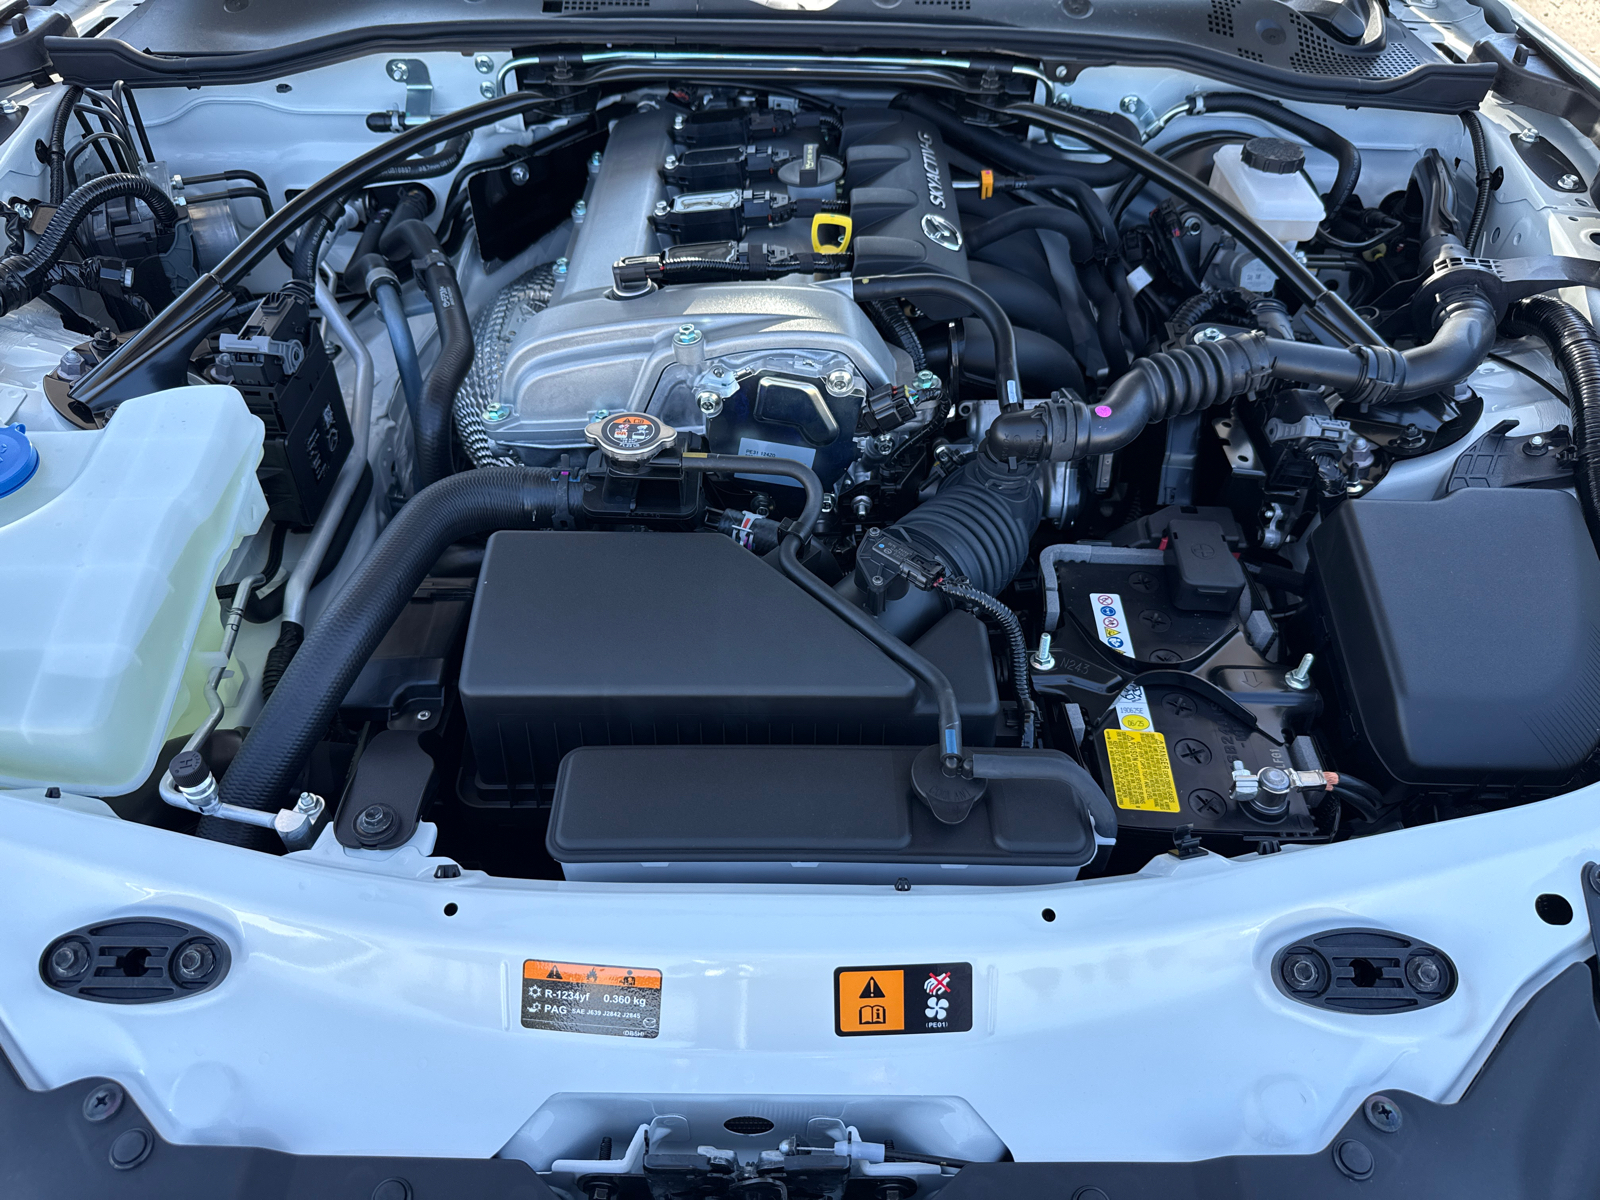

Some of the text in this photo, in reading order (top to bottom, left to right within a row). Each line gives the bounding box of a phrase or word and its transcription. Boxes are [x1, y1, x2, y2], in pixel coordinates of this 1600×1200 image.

[918, 131, 946, 209] SKYACTIV-G
[1060, 657, 1090, 675] N243
[1128, 741, 1138, 761] POISON
[1158, 745, 1169, 769] DANGER
[544, 989, 646, 1007] R-1234yf 0.360 kg
[544, 1004, 568, 1014] PAG
[602, 1010, 621, 1018] J2842
